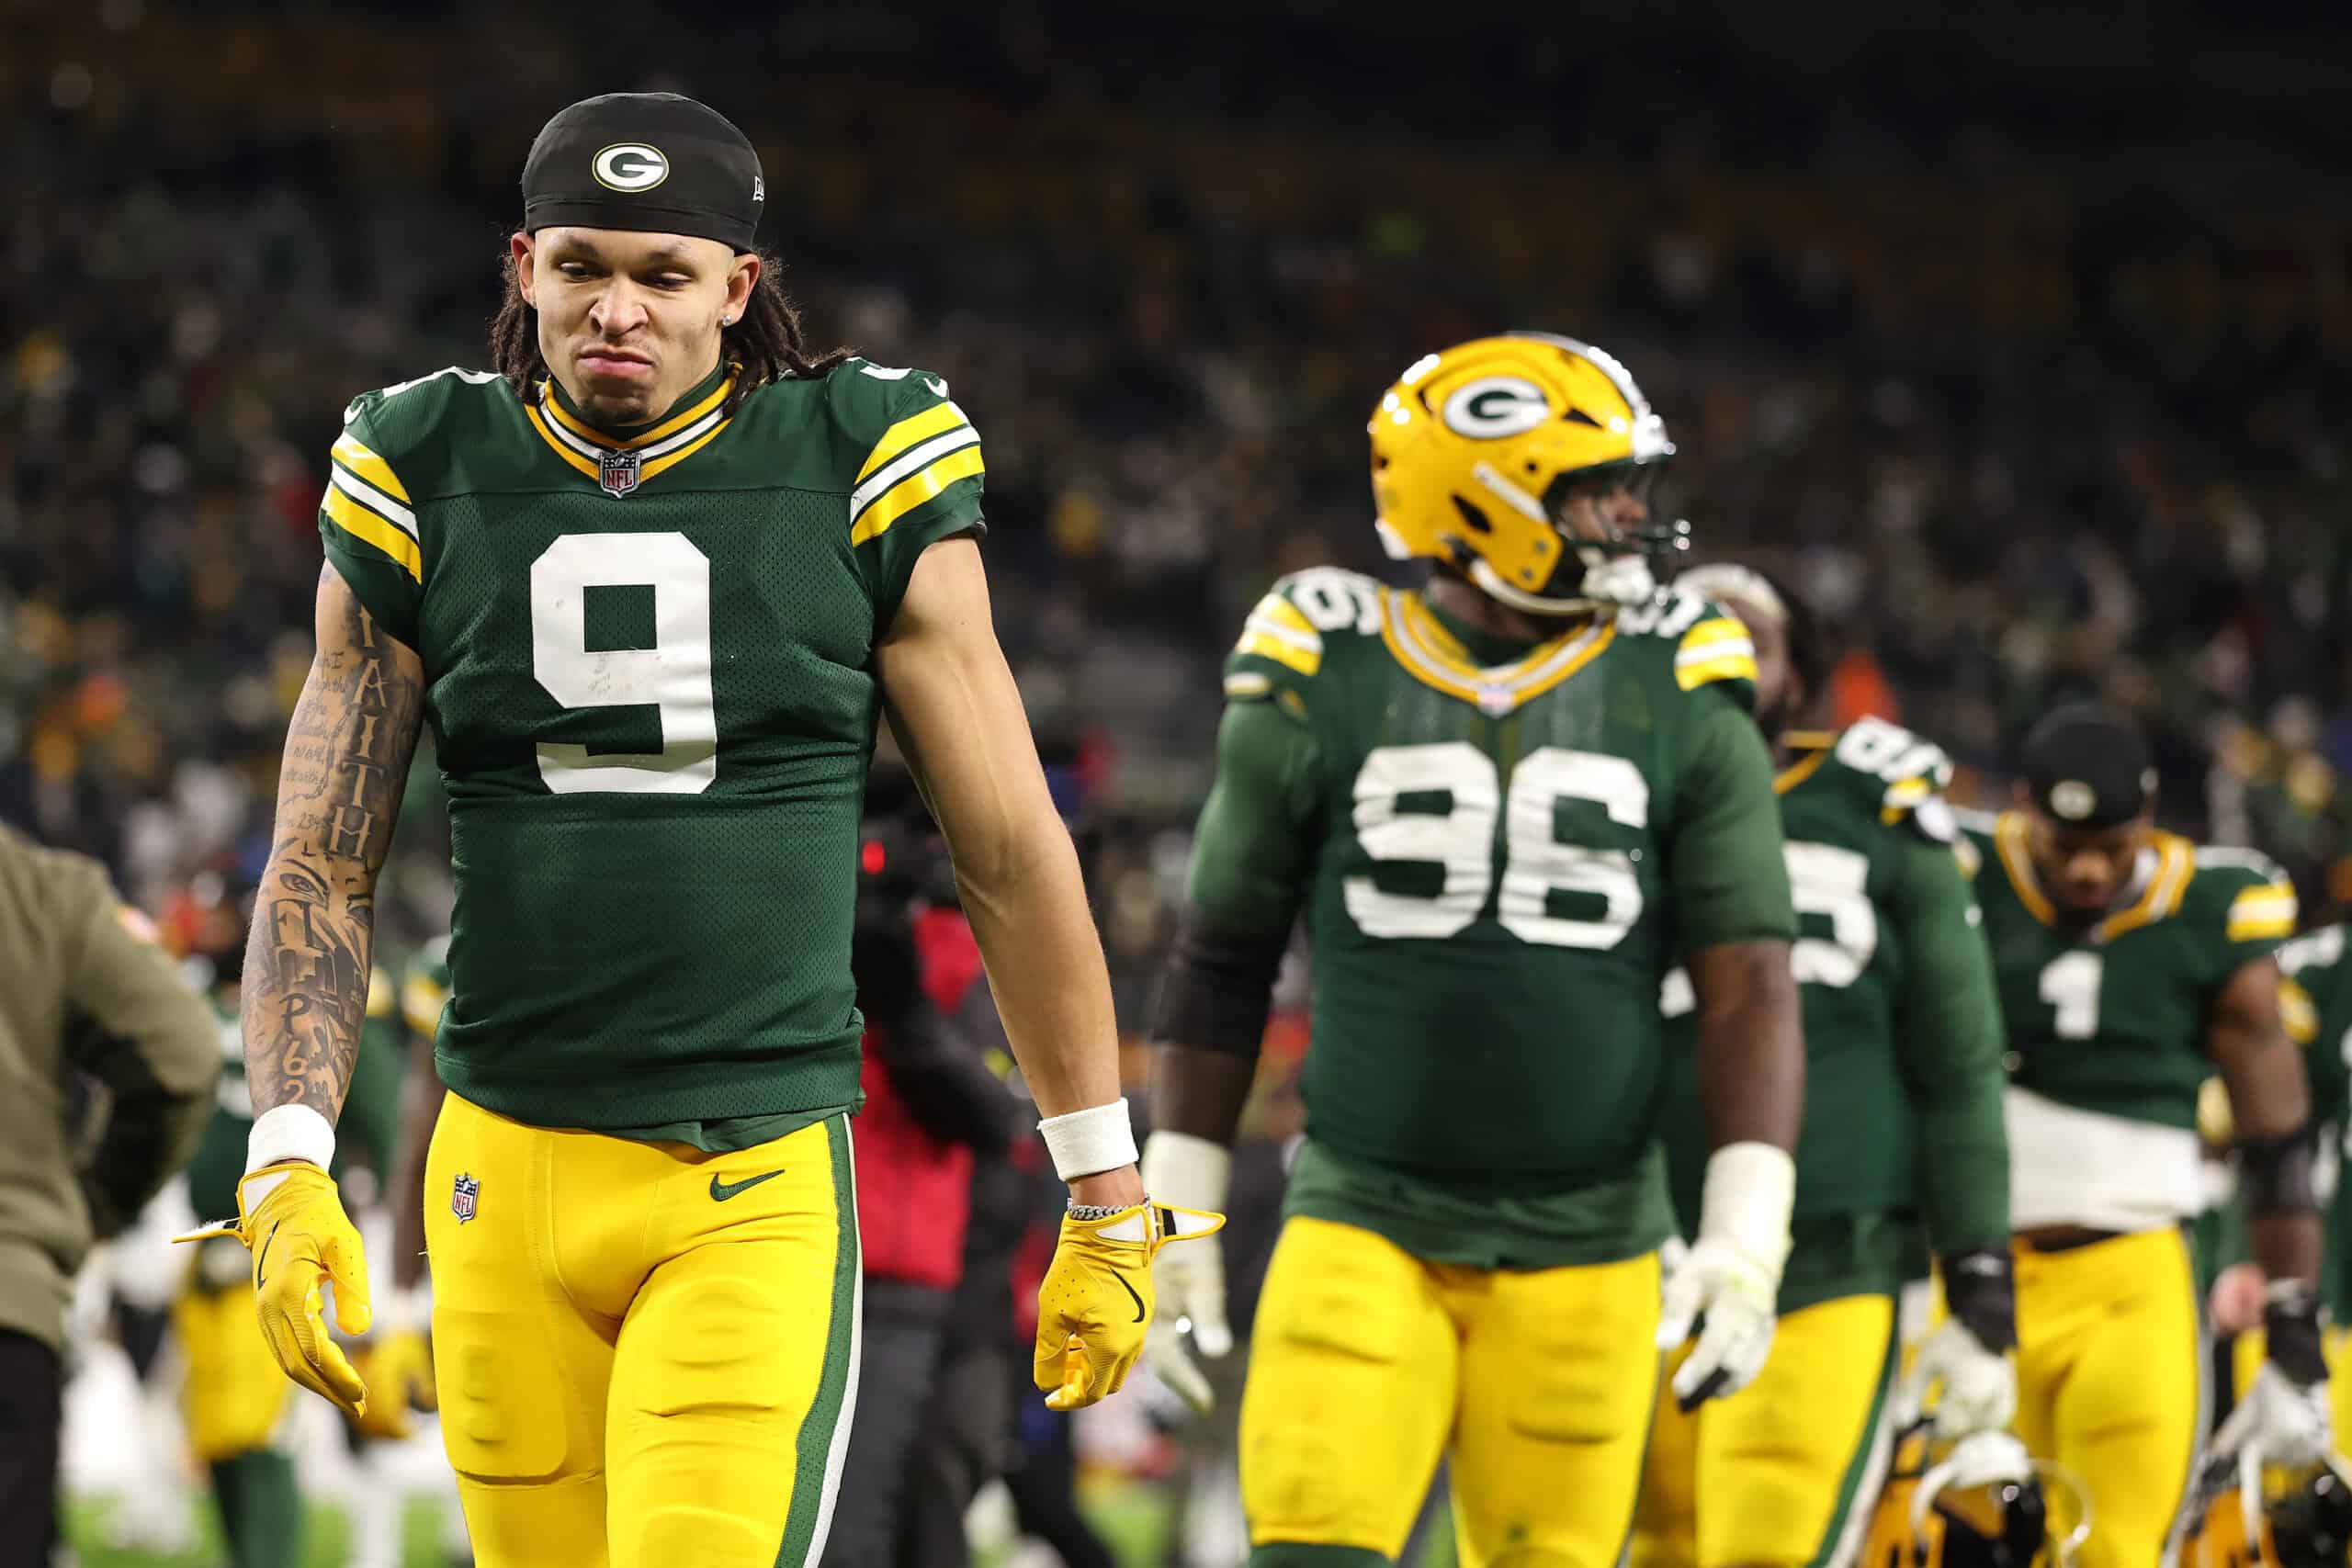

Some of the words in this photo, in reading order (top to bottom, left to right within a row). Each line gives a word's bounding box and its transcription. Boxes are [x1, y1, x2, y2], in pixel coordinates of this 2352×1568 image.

[597, 146, 665, 187] G
[1443, 376, 1550, 439] G
[605, 469, 633, 489] NFL
[530, 531, 718, 795] 9
[1343, 742, 1649, 950] 96
[2039, 949, 2103, 1040] 1
[455, 1193, 472, 1213] NFL
